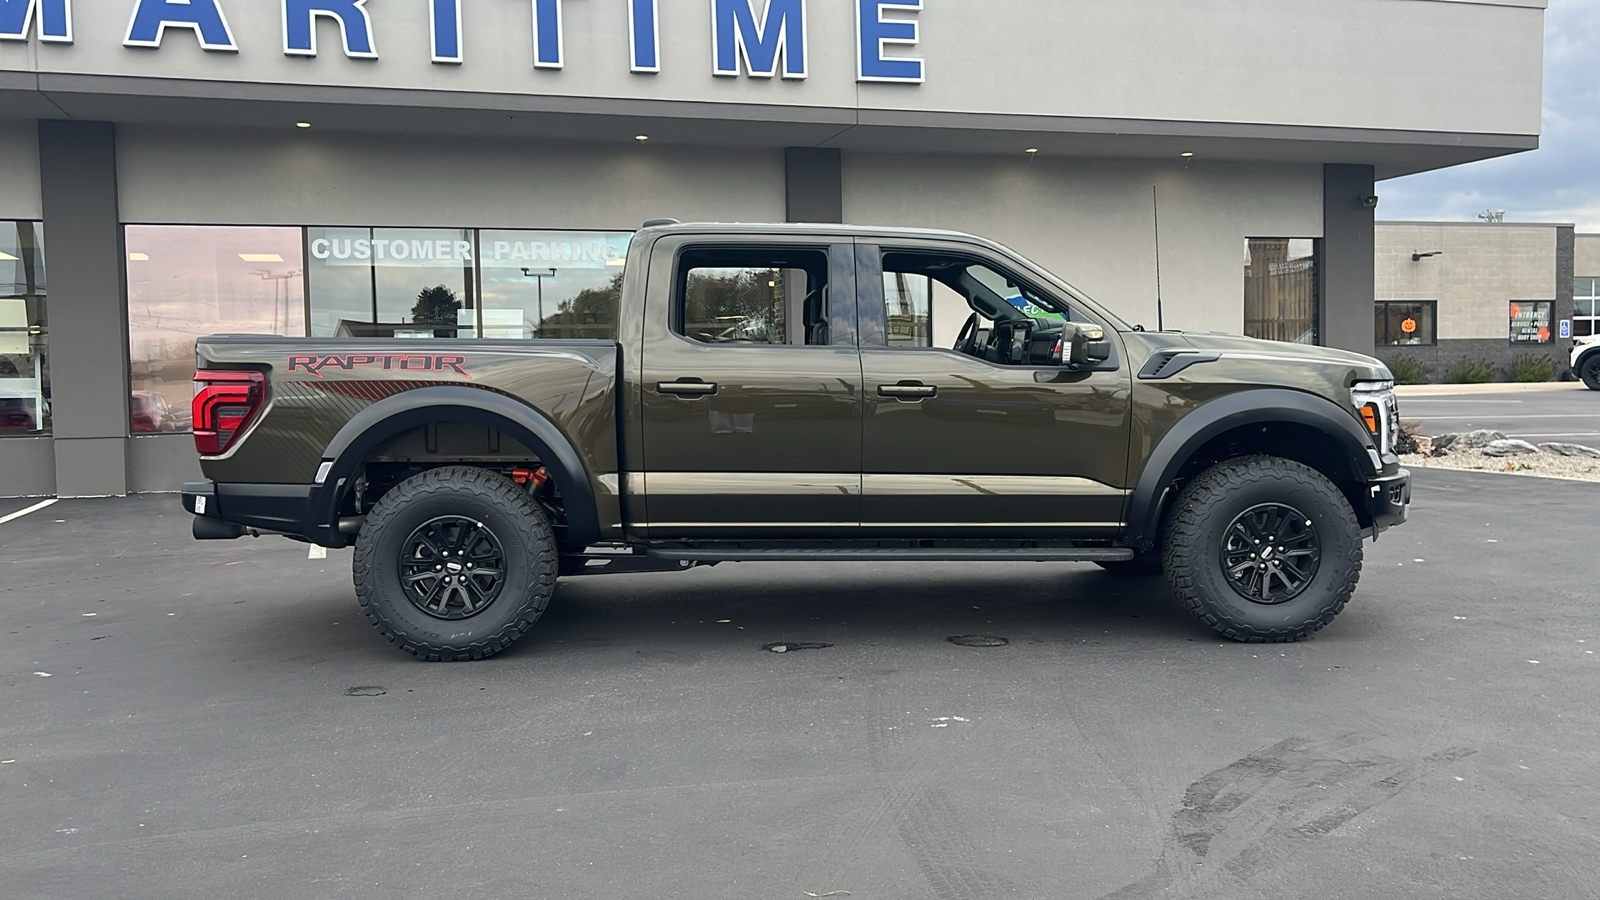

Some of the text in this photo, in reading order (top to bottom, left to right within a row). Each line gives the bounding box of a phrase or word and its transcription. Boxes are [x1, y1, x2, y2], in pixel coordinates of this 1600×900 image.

[311, 238, 620, 261] CUSTOMER PARKING
[1514, 311, 1546, 319] ENTRANCE
[287, 355, 472, 379] RAPTOR
